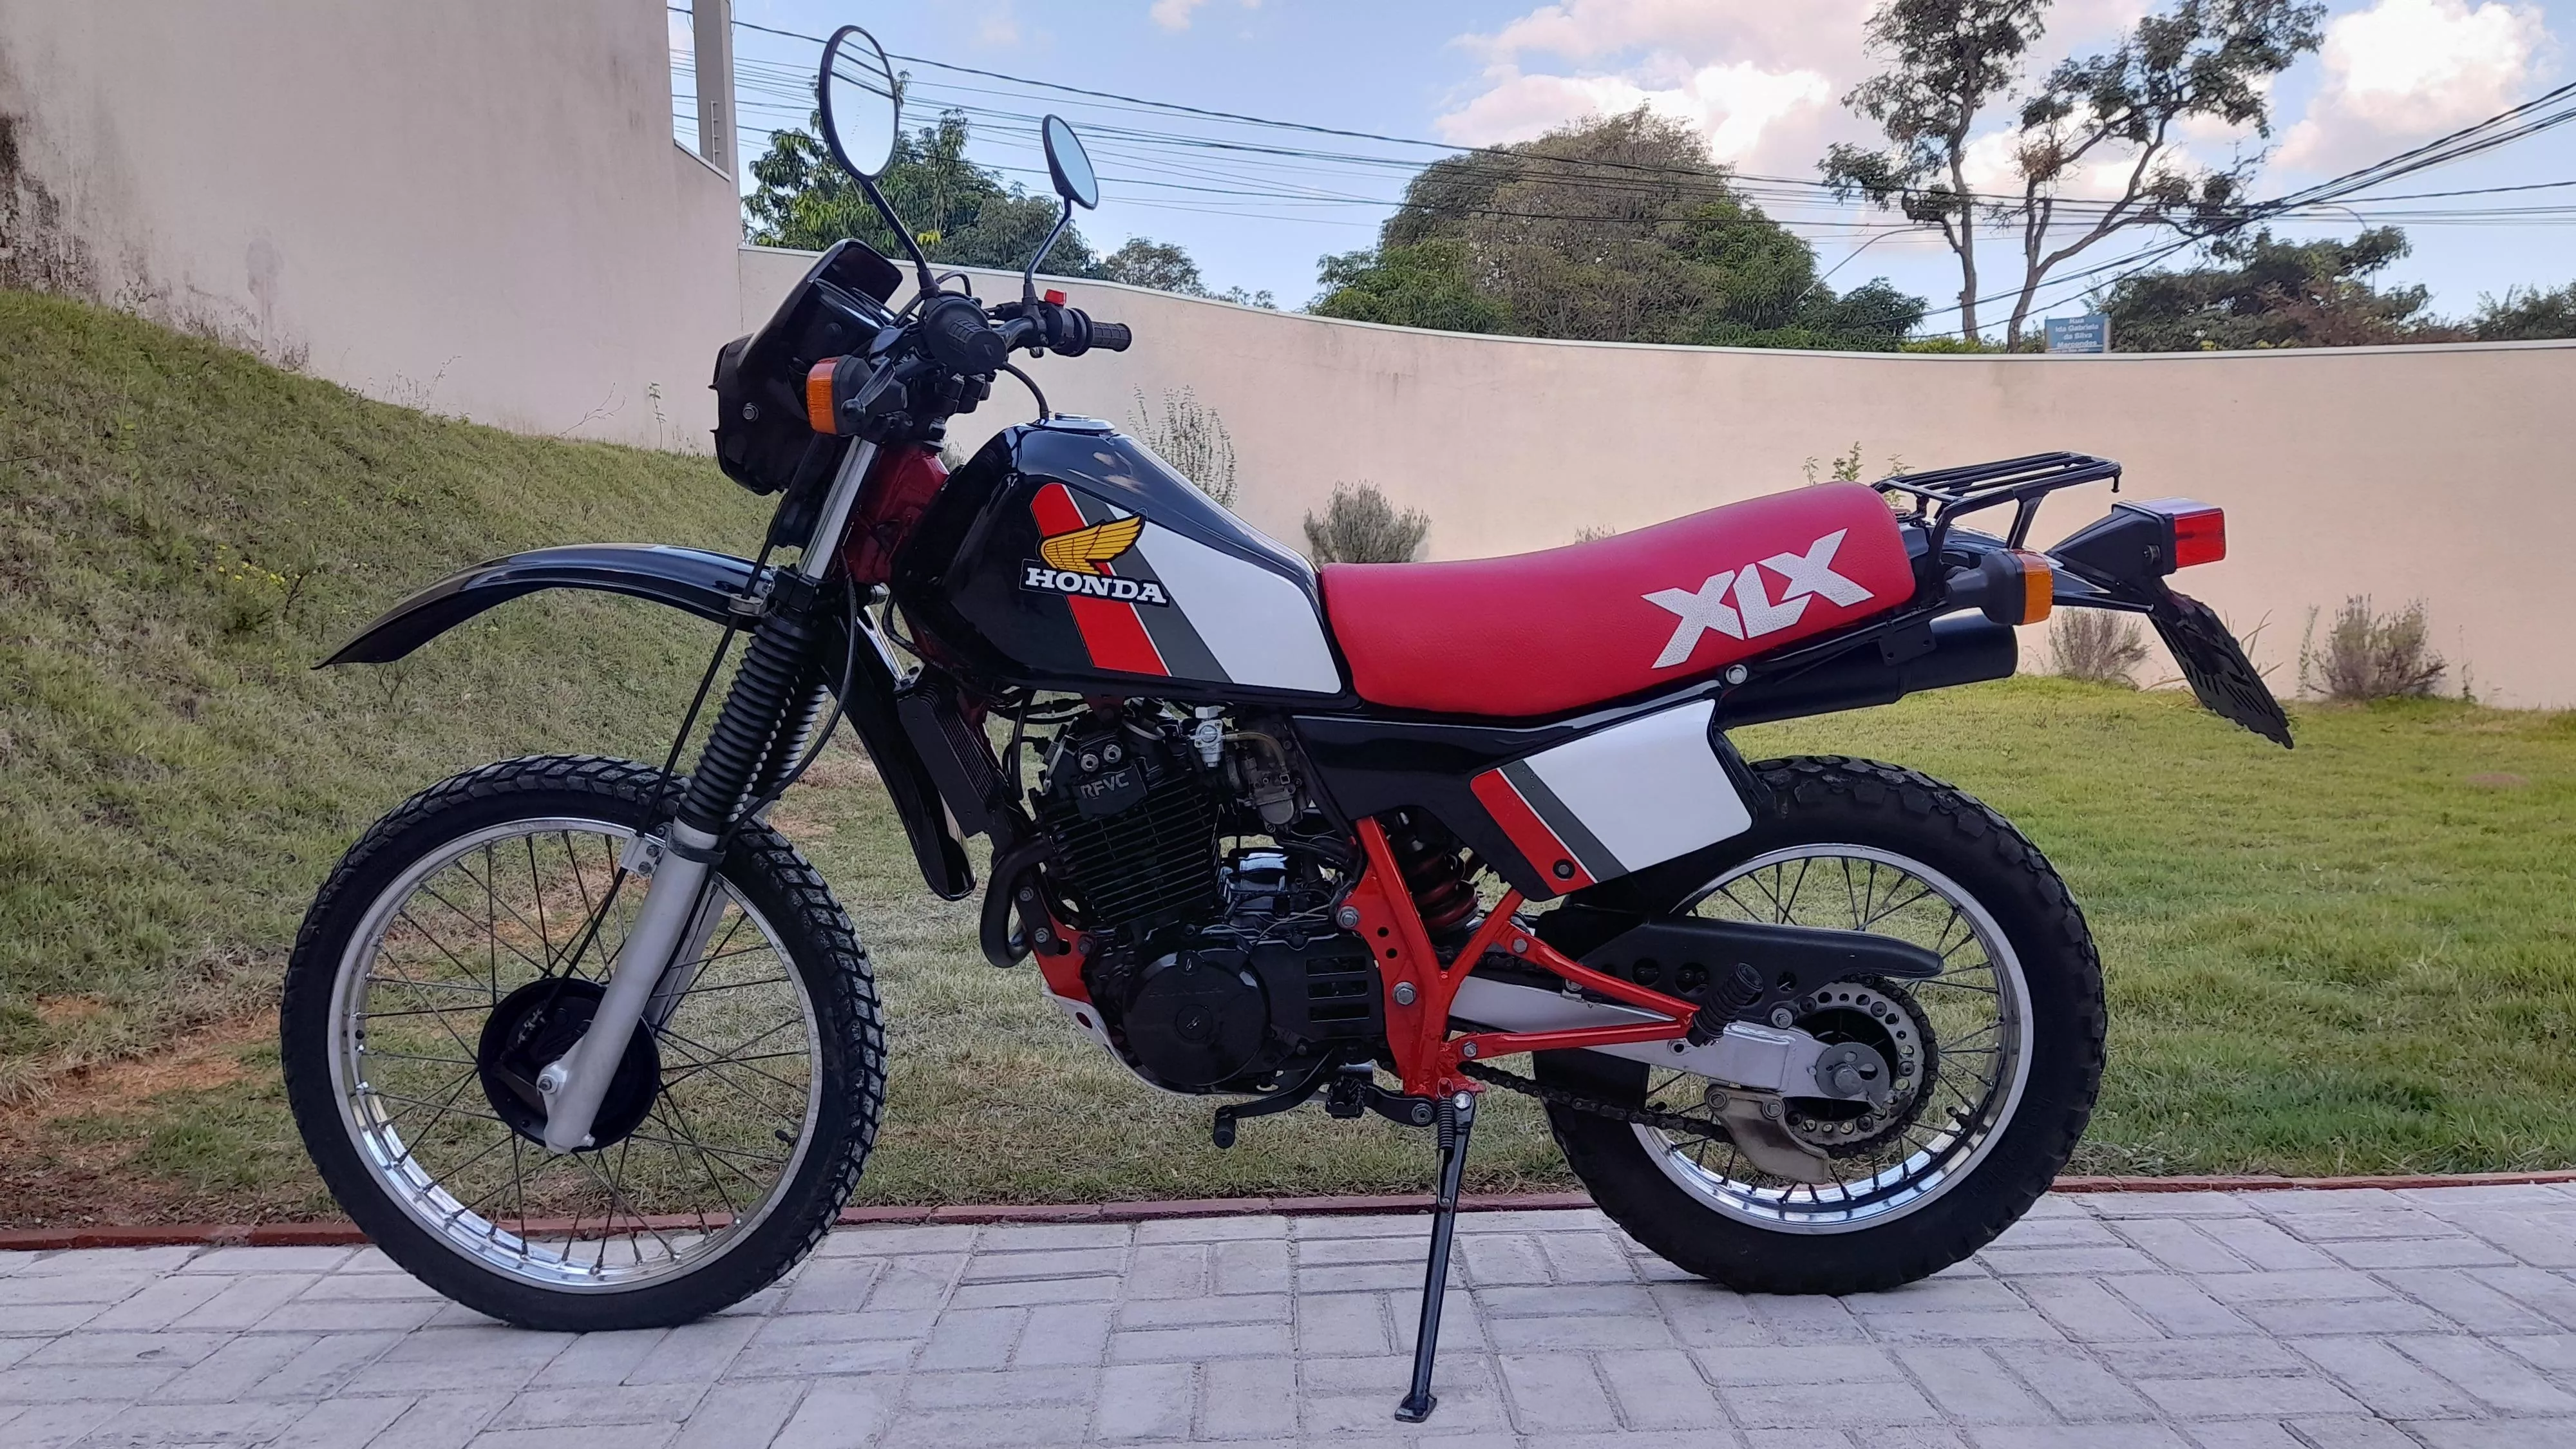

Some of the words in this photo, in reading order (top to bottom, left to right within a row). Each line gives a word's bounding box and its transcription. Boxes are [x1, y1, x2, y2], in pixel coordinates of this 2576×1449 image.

[1025, 567, 1166, 603] HONDA
[1640, 527, 1875, 669] XLX
[1079, 772, 1130, 800] RFVC
